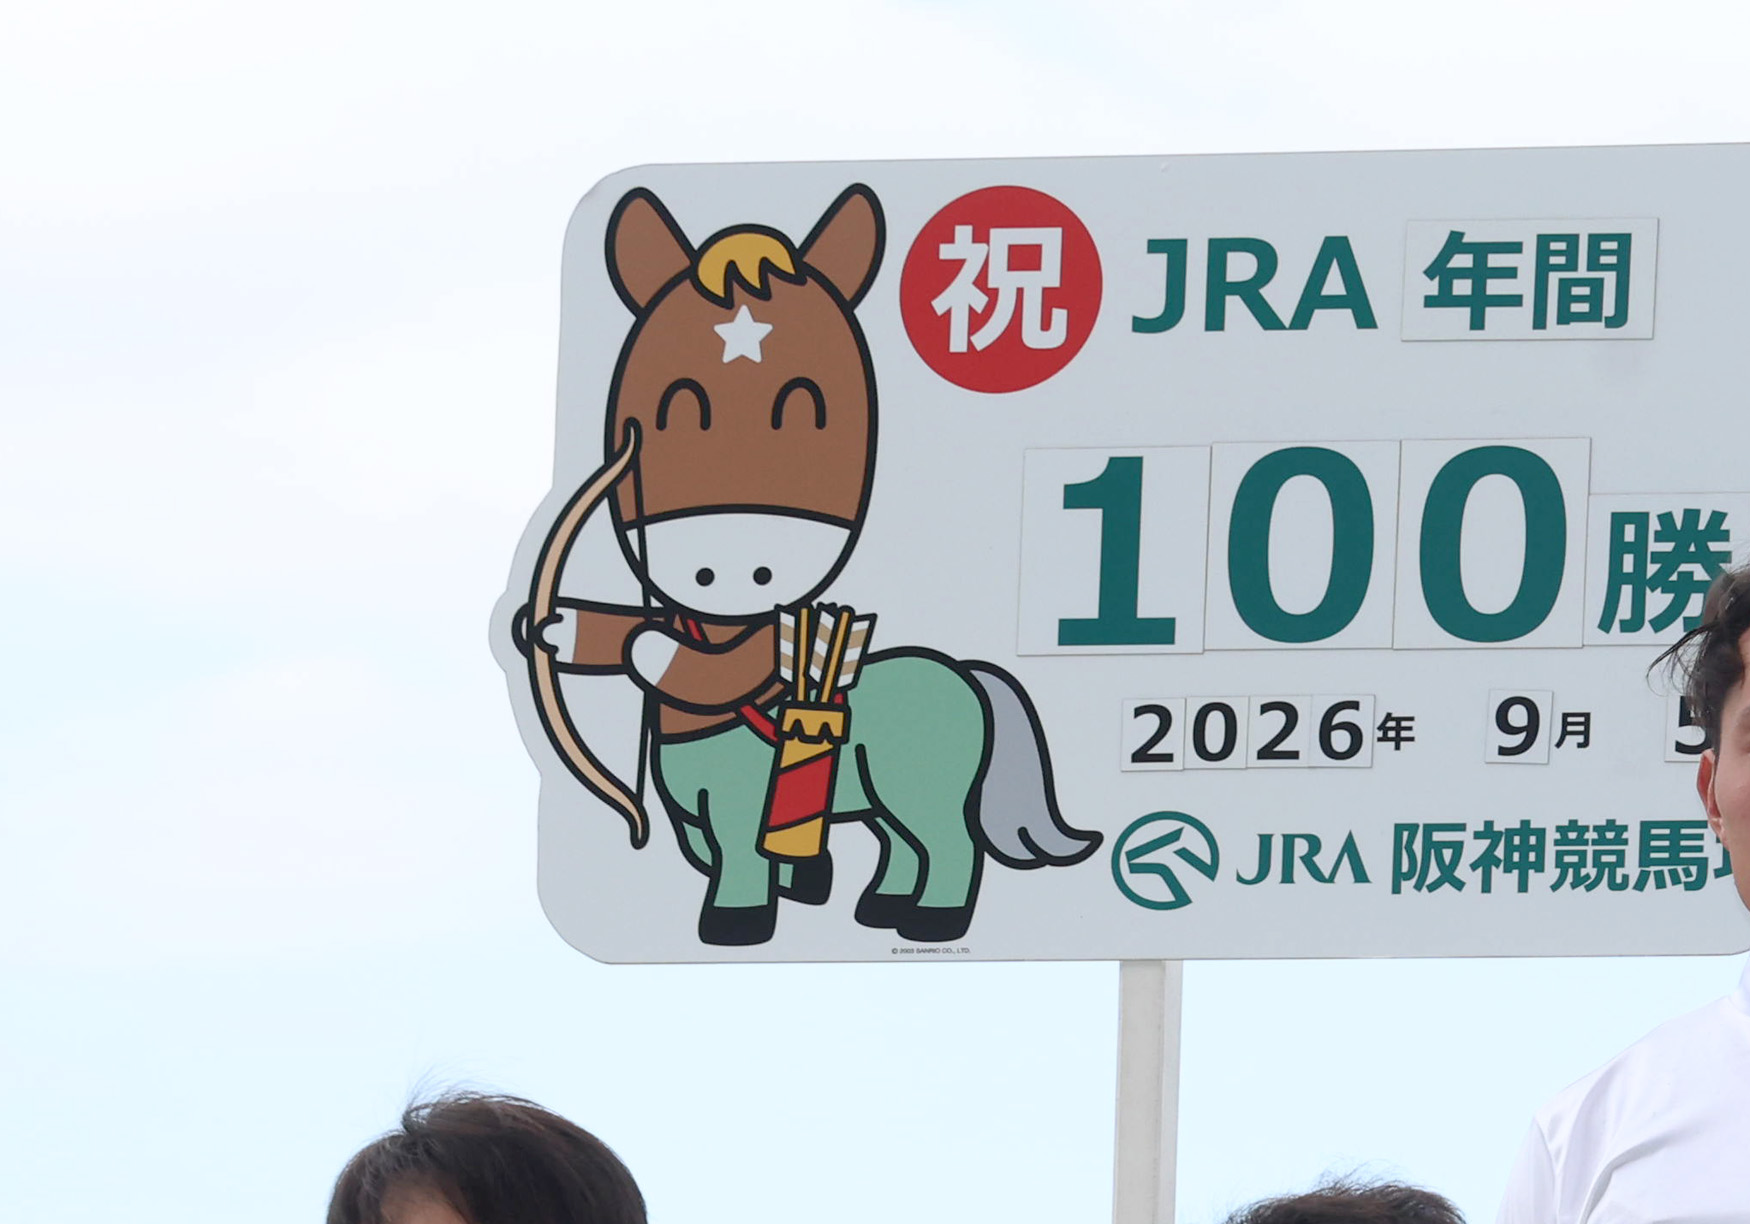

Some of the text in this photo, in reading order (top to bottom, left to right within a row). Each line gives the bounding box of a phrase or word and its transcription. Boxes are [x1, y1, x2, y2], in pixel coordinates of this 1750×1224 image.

[930, 223, 1070, 355] 祝
[1132, 230, 1632, 334] JRA 年間
[1236, 819, 1733, 894] JRA 阪神競馬
